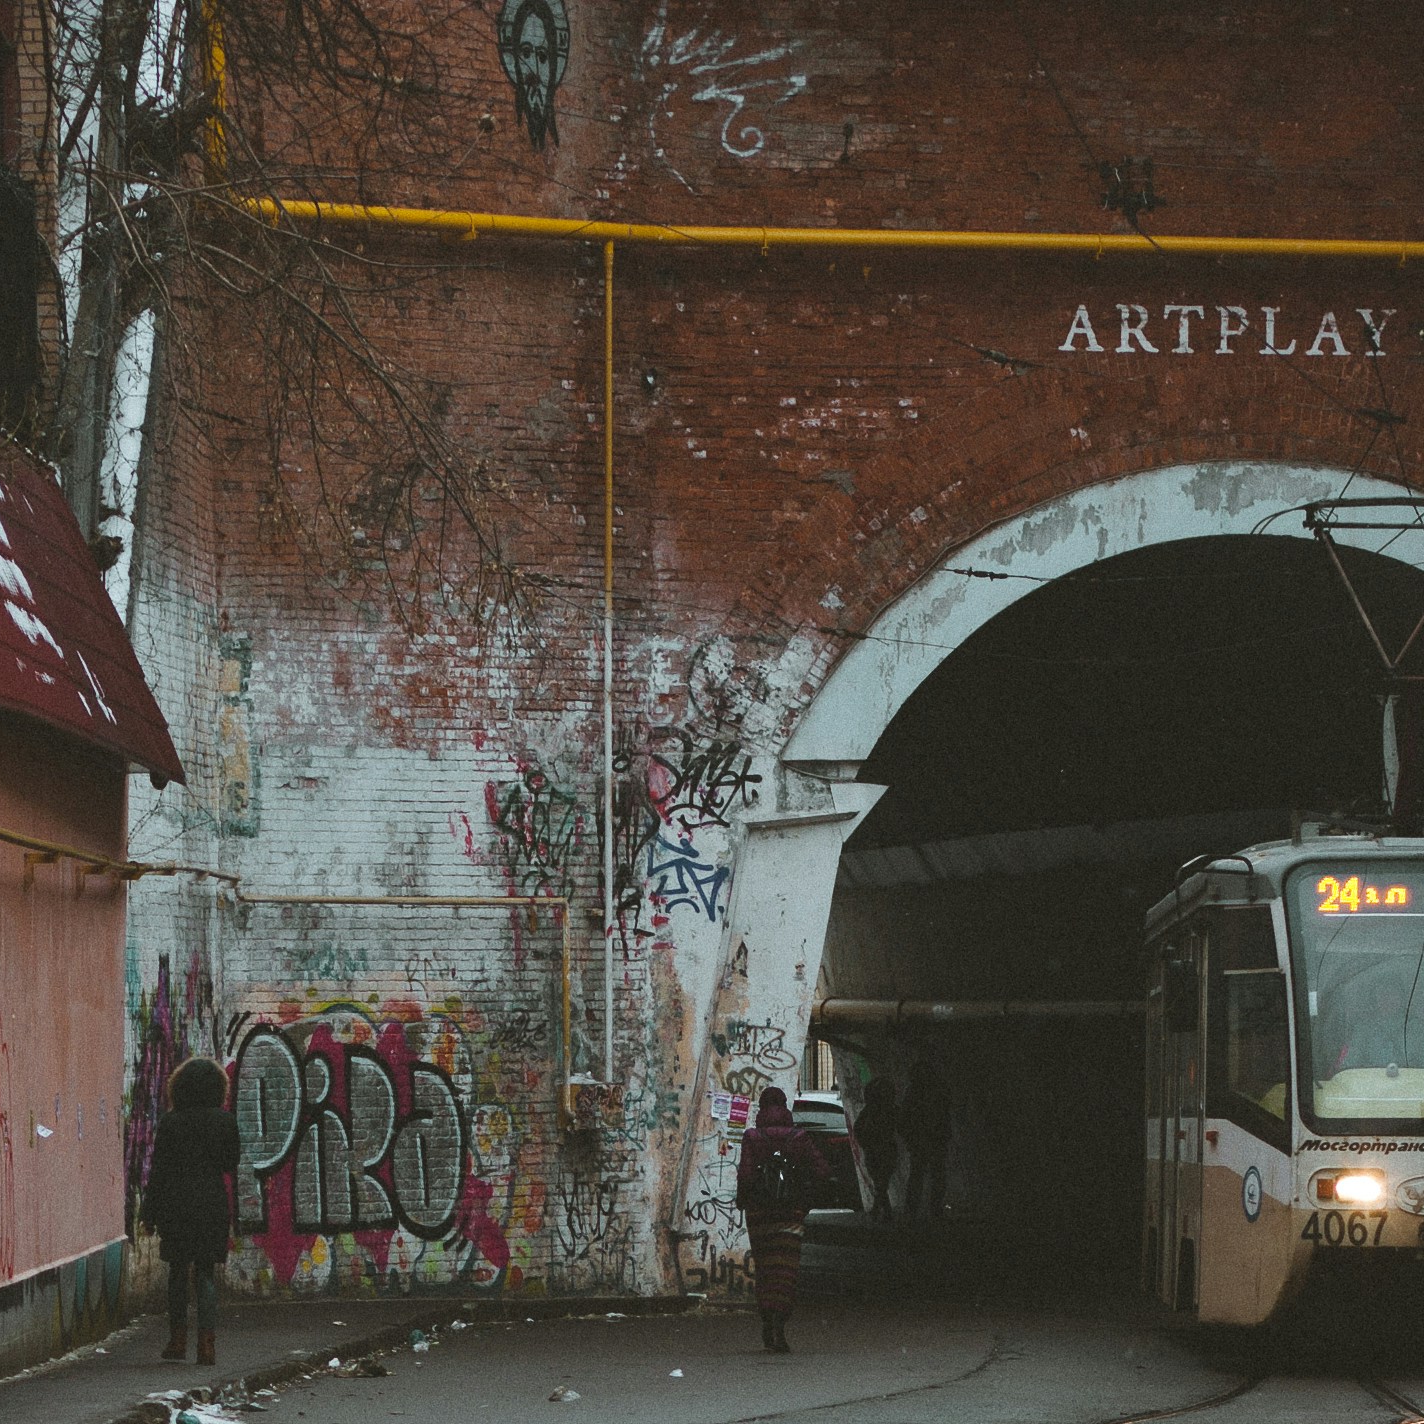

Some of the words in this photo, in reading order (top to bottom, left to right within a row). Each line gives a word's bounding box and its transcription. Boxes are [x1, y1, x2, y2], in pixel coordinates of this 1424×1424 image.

[1058, 304, 1397, 357] ARTPLAY
[1318, 876, 1361, 912] 24
[1301, 1211, 1389, 1246] 4067
